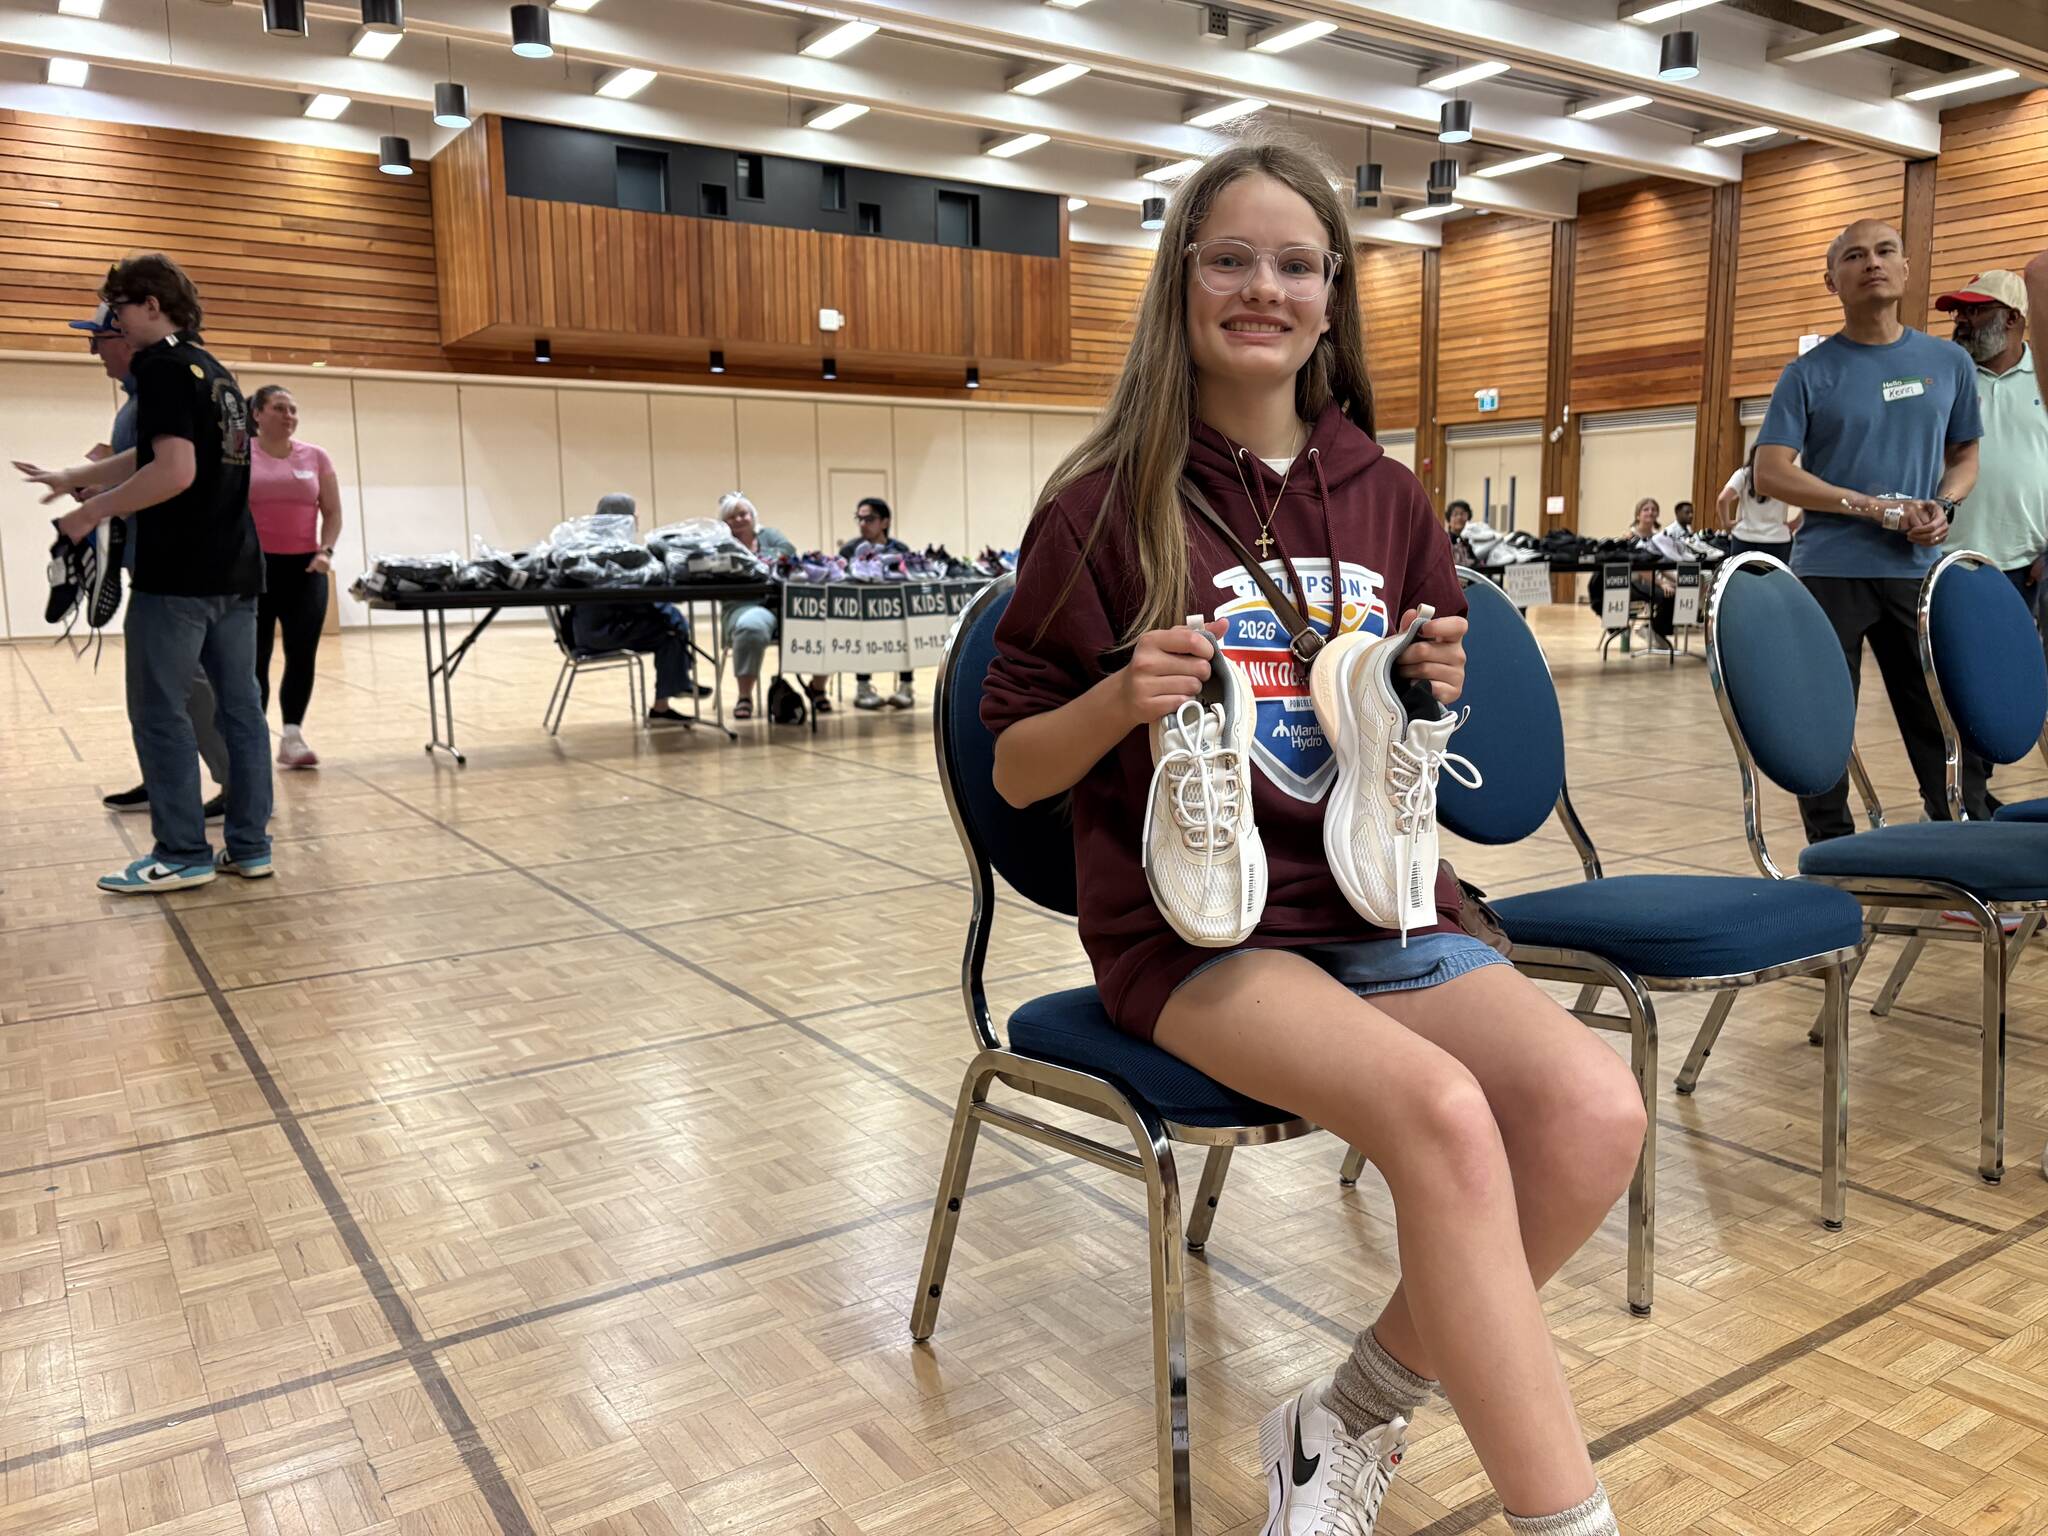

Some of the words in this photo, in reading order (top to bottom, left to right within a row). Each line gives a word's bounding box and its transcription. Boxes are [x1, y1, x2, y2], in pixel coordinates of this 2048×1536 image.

[1248, 575, 1361, 598] TOMPSON
[793, 596, 827, 618] KIDS
[833, 596, 862, 618] KID
[868, 597, 902, 618] KIDS
[911, 593, 945, 614] KIDS
[1238, 619, 1277, 641] 2026
[791, 638, 825, 655] 8-8.5
[1237, 660, 1300, 687] ANITOB
[1290, 699, 1313, 708] POWERE
[1290, 724, 1324, 737] Manit
[1291, 736, 1322, 751] Hydro
